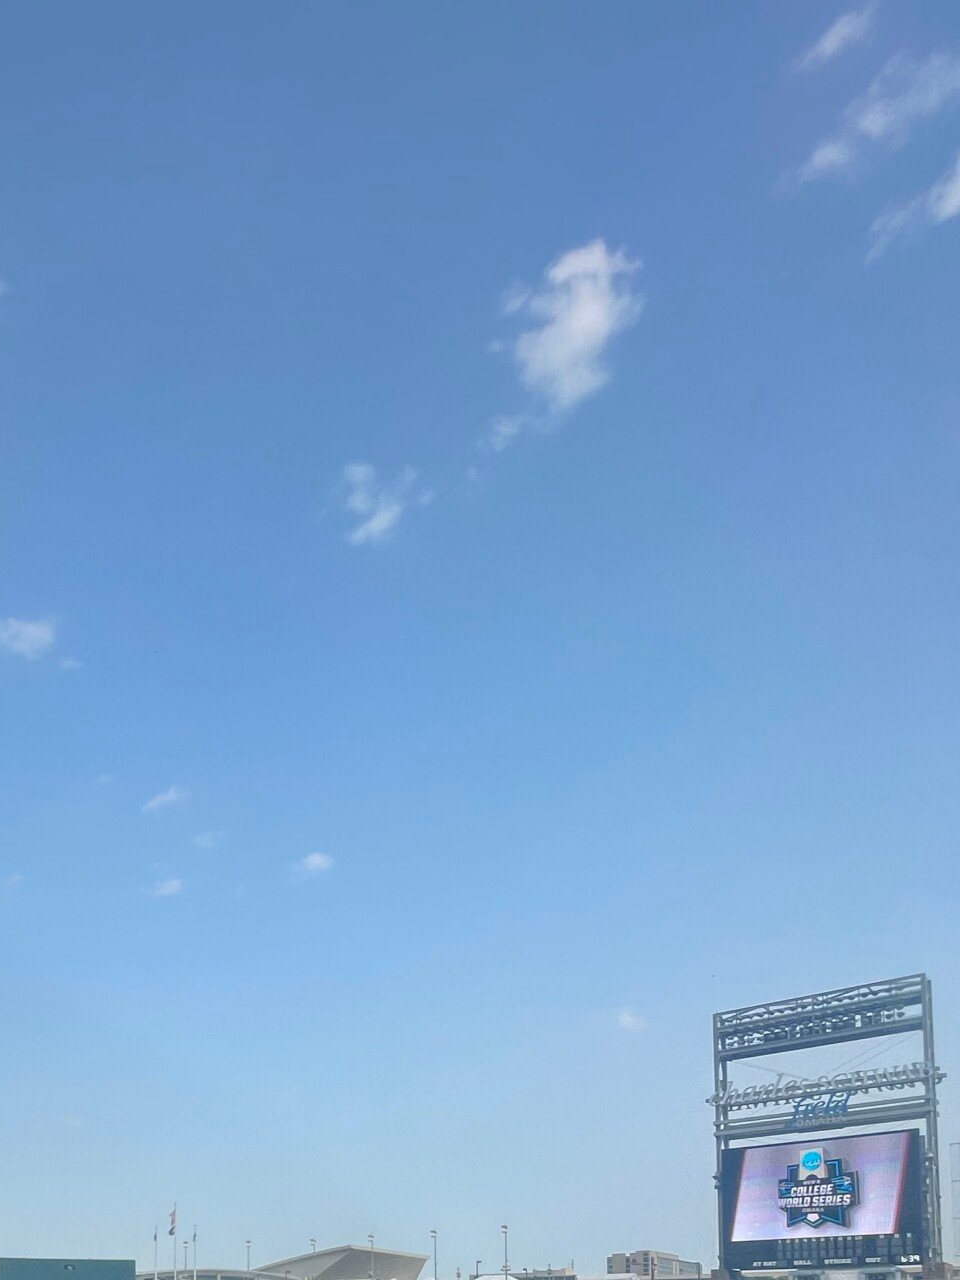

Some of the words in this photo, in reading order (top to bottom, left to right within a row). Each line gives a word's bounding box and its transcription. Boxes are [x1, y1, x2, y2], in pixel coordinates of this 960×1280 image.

[791, 1184, 834, 1197] COLLEGE
[778, 1196, 810, 1208] WORLD
[812, 1194, 851, 1206] SERIES
